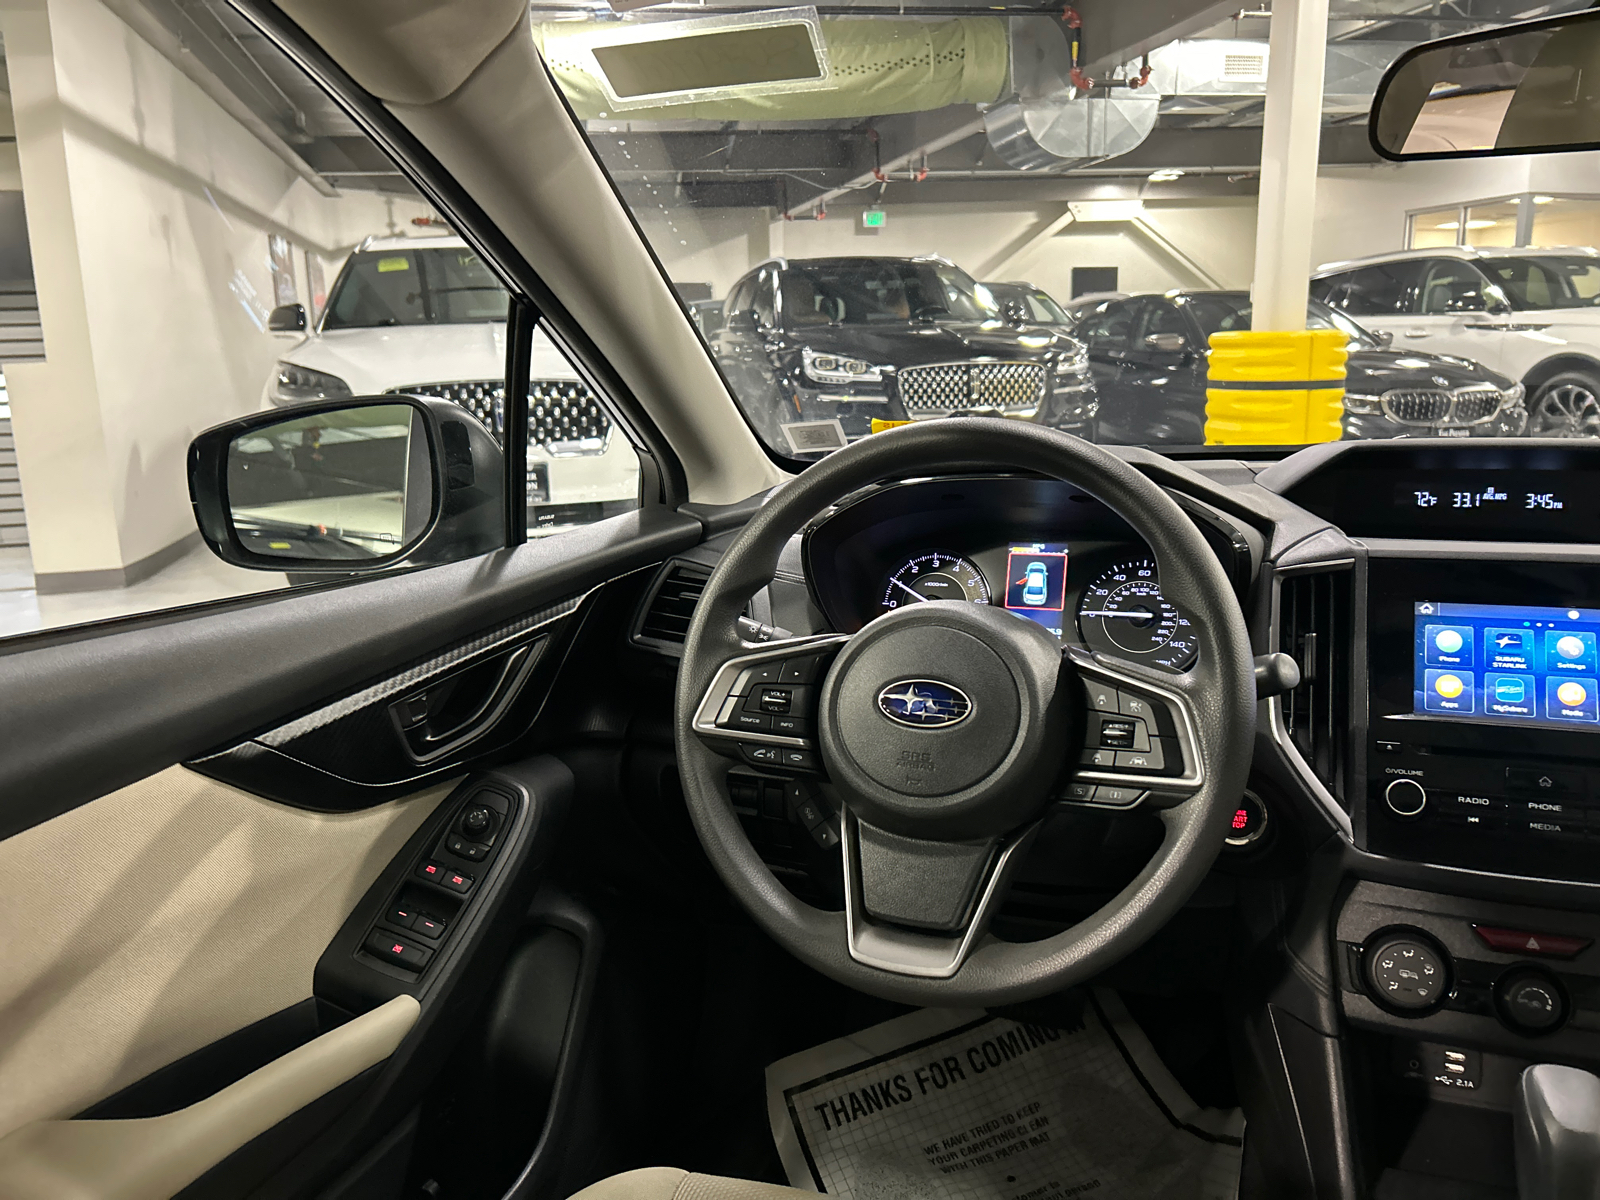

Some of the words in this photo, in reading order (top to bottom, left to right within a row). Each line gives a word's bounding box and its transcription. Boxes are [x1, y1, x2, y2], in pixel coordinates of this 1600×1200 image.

[911, 565, 919, 573] 2
[931, 560, 940, 568] 3
[952, 565, 960, 573] 4
[967, 579, 975, 587] 5
[889, 600, 897, 608] 0
[1494, 655, 1525, 663] SUBARU
[1492, 662, 1527, 670] STARLINK
[1556, 662, 1586, 670] Settings
[901, 750, 932, 762] SRS
[1458, 796, 1490, 806] RADIO
[1528, 802, 1563, 812] PHONE
[1529, 822, 1562, 832] MEDIA
[1456, 1078, 1475, 1089] 2.1A
[814, 1074, 912, 1131] THANKS
[914, 1055, 967, 1095] FOR
[923, 1143, 940, 1155] WE
[942, 1132, 970, 1150] HAVE
[969, 1119, 1000, 1139] TRIED
[1001, 1113, 1016, 1125] TO
[1016, 1102, 1041, 1120] KEEP
[928, 1152, 959, 1166] YOUR
[960, 1129, 1017, 1157] CARPETING
[1016, 1116, 1050, 1136] CLEAN
[940, 1161, 969, 1174] WITH
[969, 1153, 994, 1167] THIS
[994, 1140, 1029, 1159] PAPER
[1028, 1132, 1051, 1148] MAT
